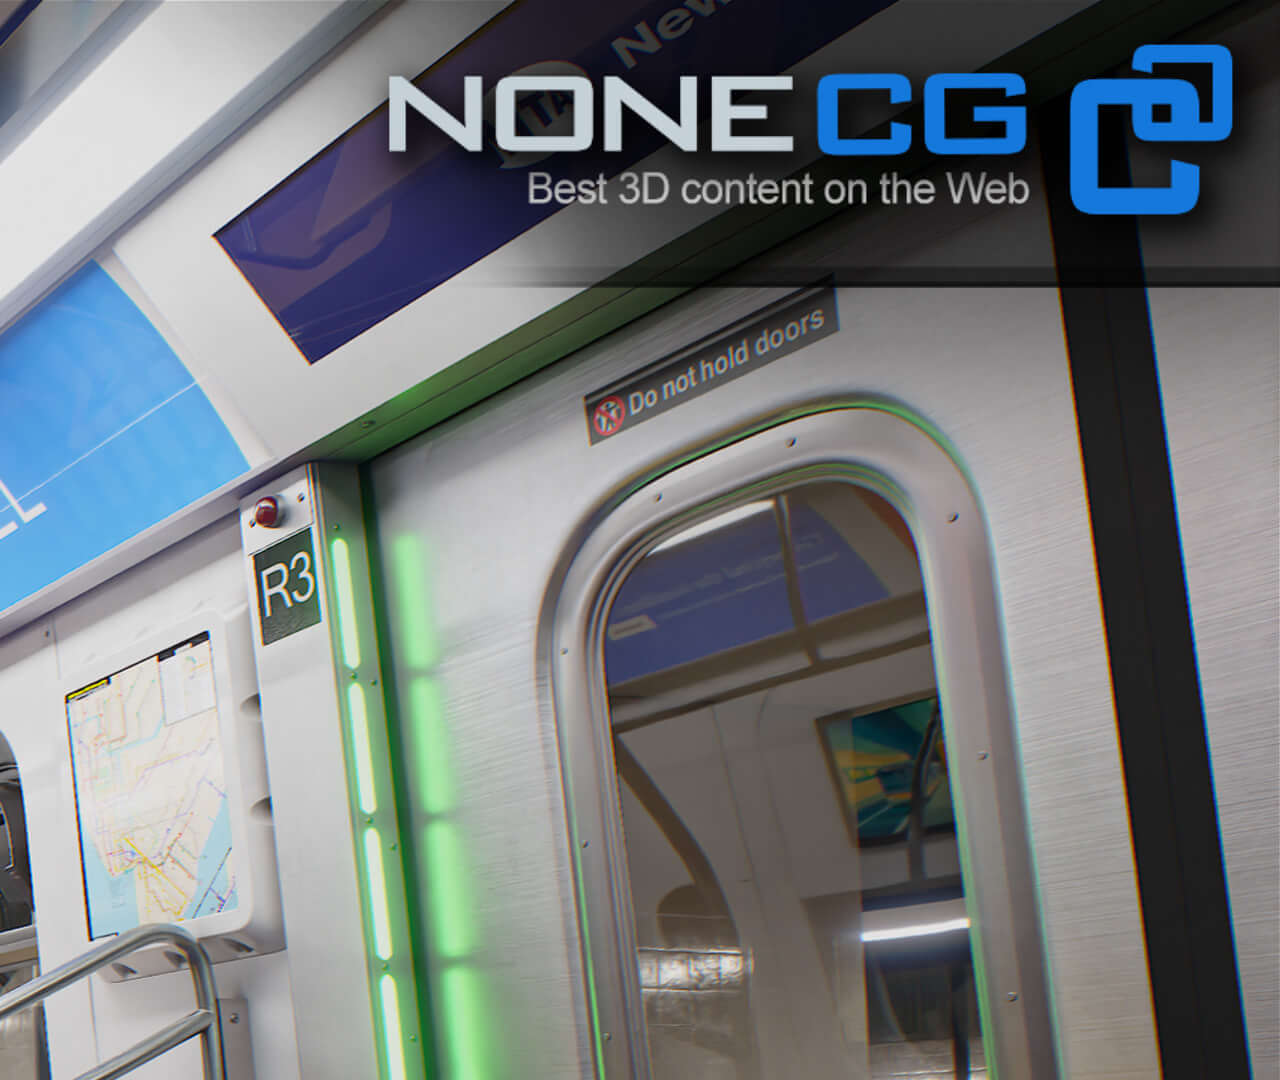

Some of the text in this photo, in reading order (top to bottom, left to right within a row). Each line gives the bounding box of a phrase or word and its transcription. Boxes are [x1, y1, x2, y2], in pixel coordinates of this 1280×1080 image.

[628, 309, 825, 416] Do not hold doors
[260, 551, 315, 617] R3
